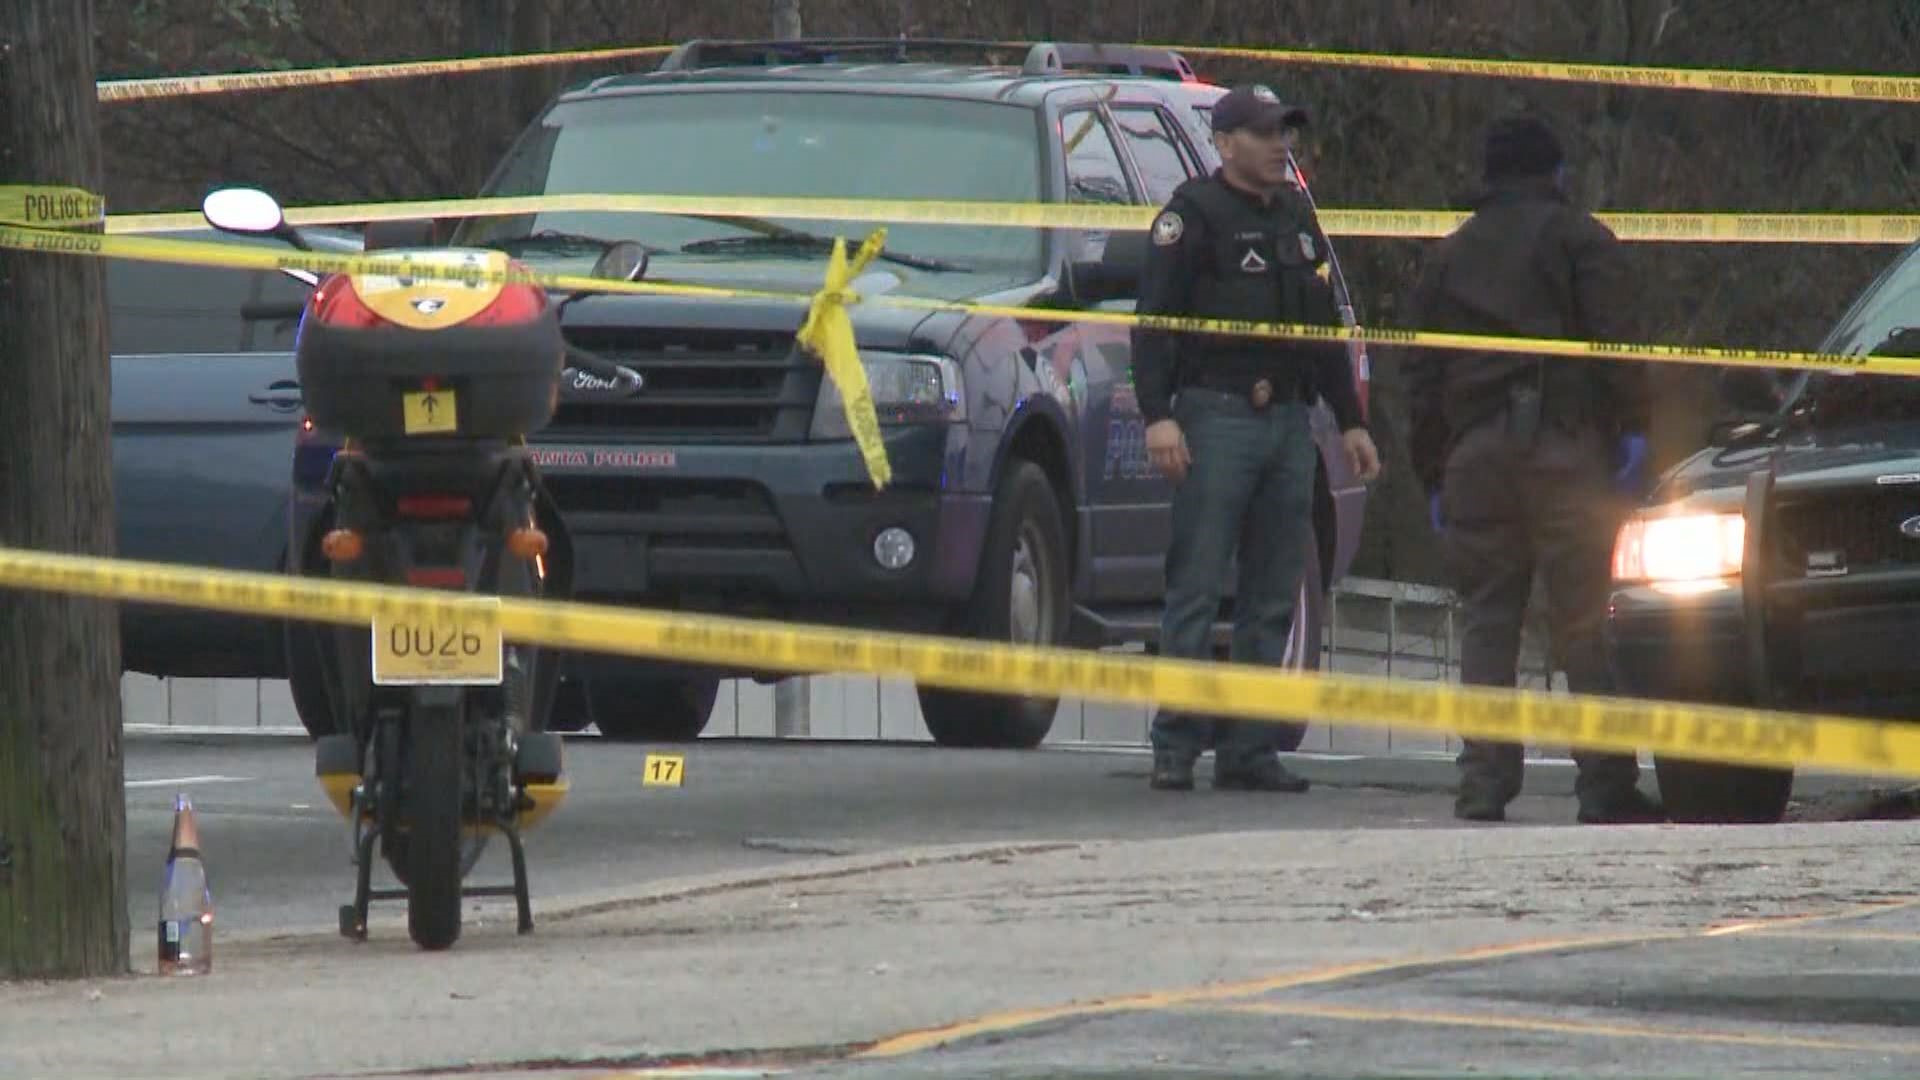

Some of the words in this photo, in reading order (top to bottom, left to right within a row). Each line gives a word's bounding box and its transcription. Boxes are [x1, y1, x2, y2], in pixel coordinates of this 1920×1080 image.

[573, 371, 617, 389] Ford
[594, 448, 676, 467] POLICE
[391, 621, 481, 657] 0026
[651, 760, 677, 780] 17
